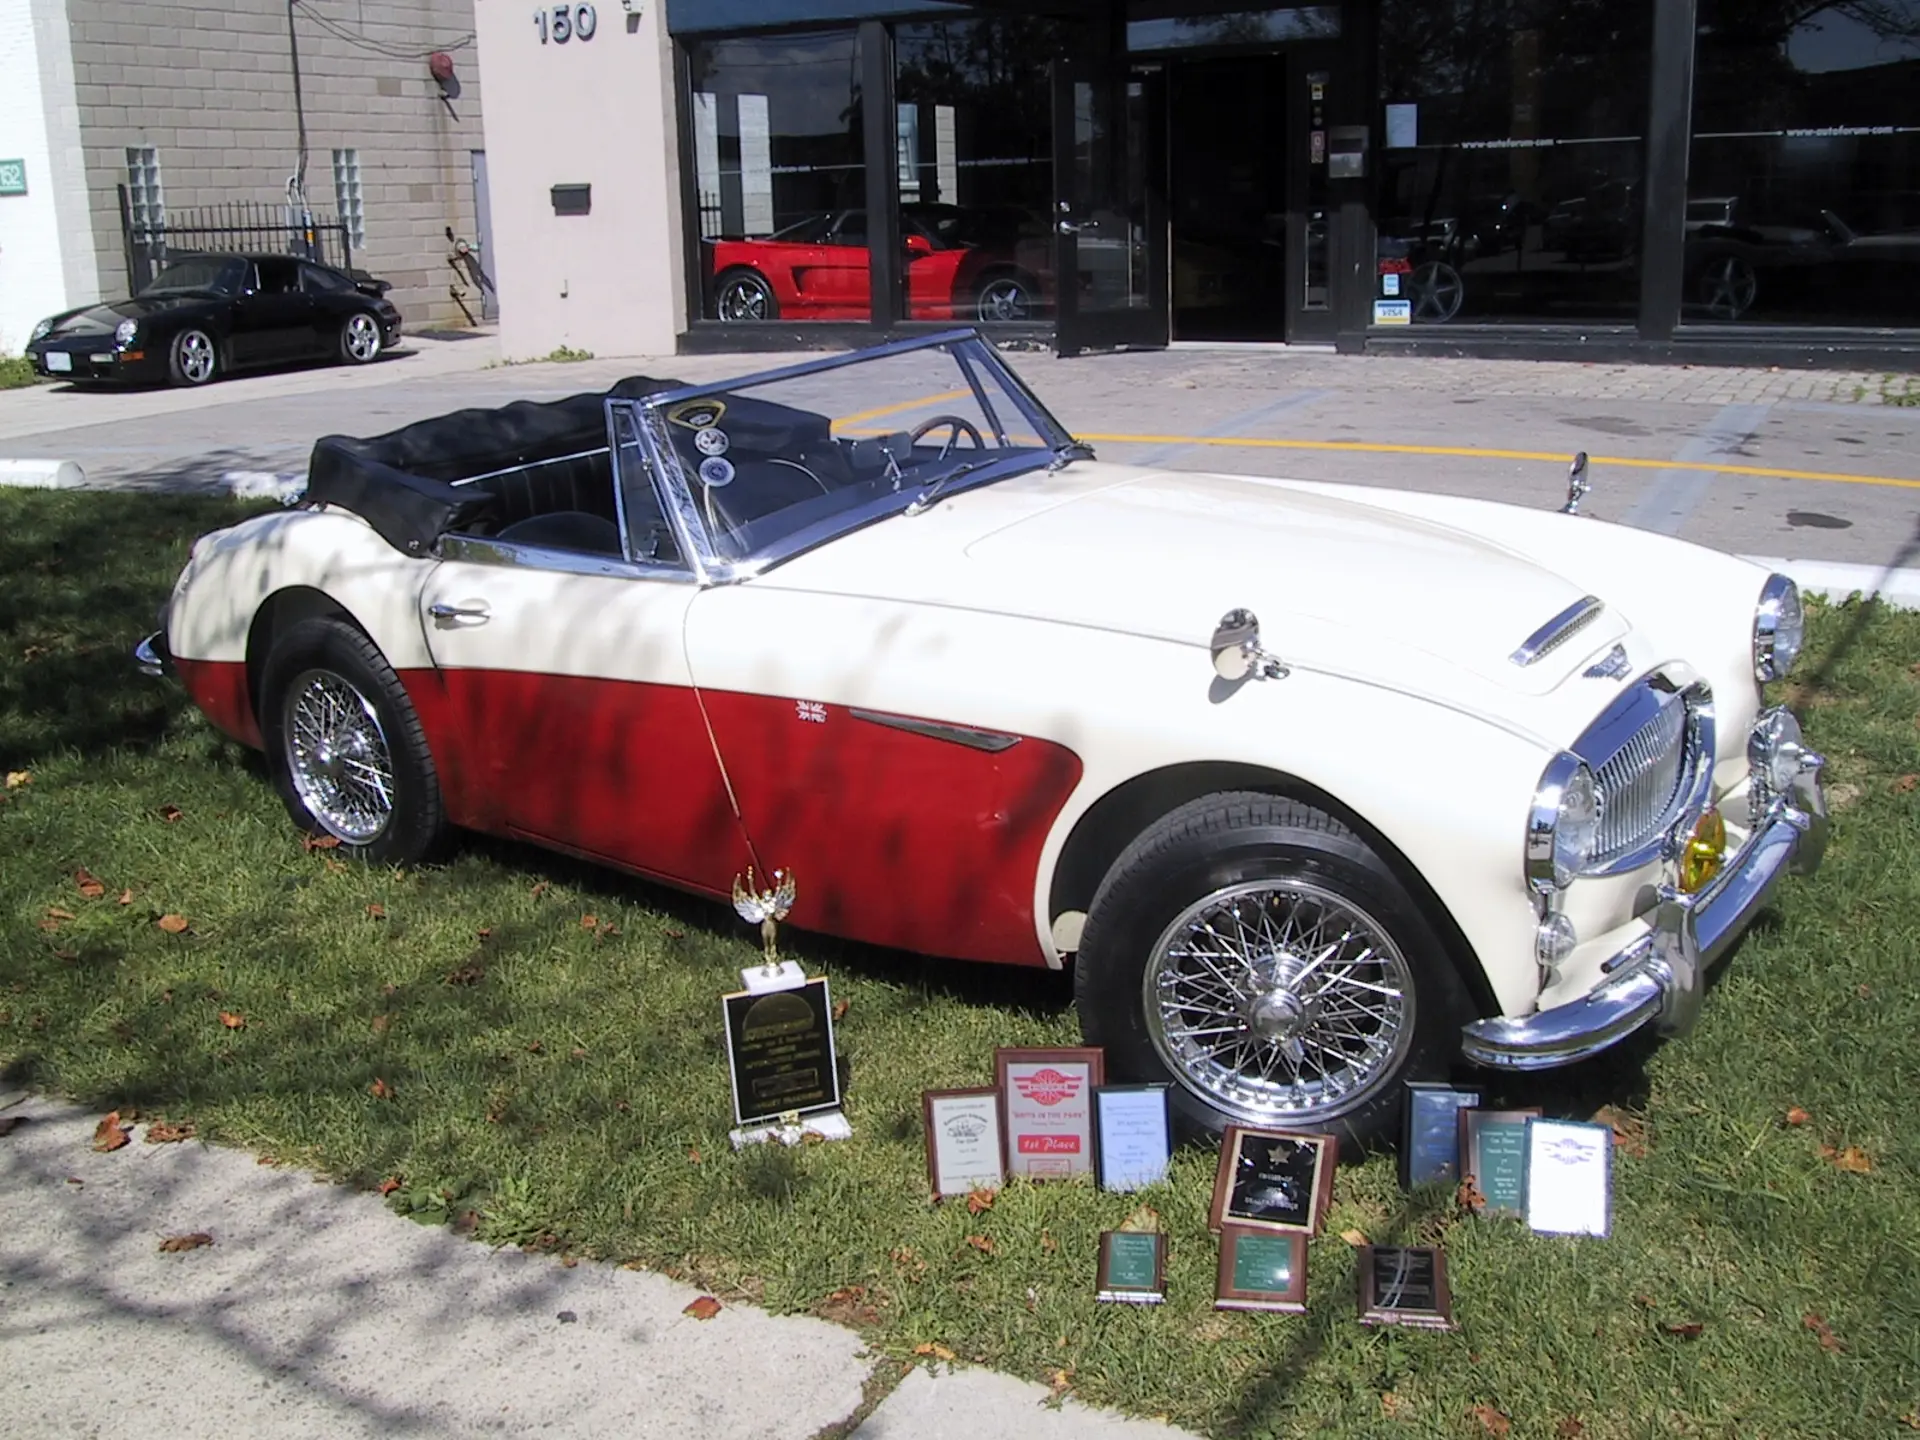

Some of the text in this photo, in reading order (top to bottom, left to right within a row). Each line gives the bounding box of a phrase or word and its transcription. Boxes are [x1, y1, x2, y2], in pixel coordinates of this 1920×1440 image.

[533, 3, 597, 45] 150
[1382, 307, 1403, 317] VISA
[1041, 1136, 1076, 1152] Place
